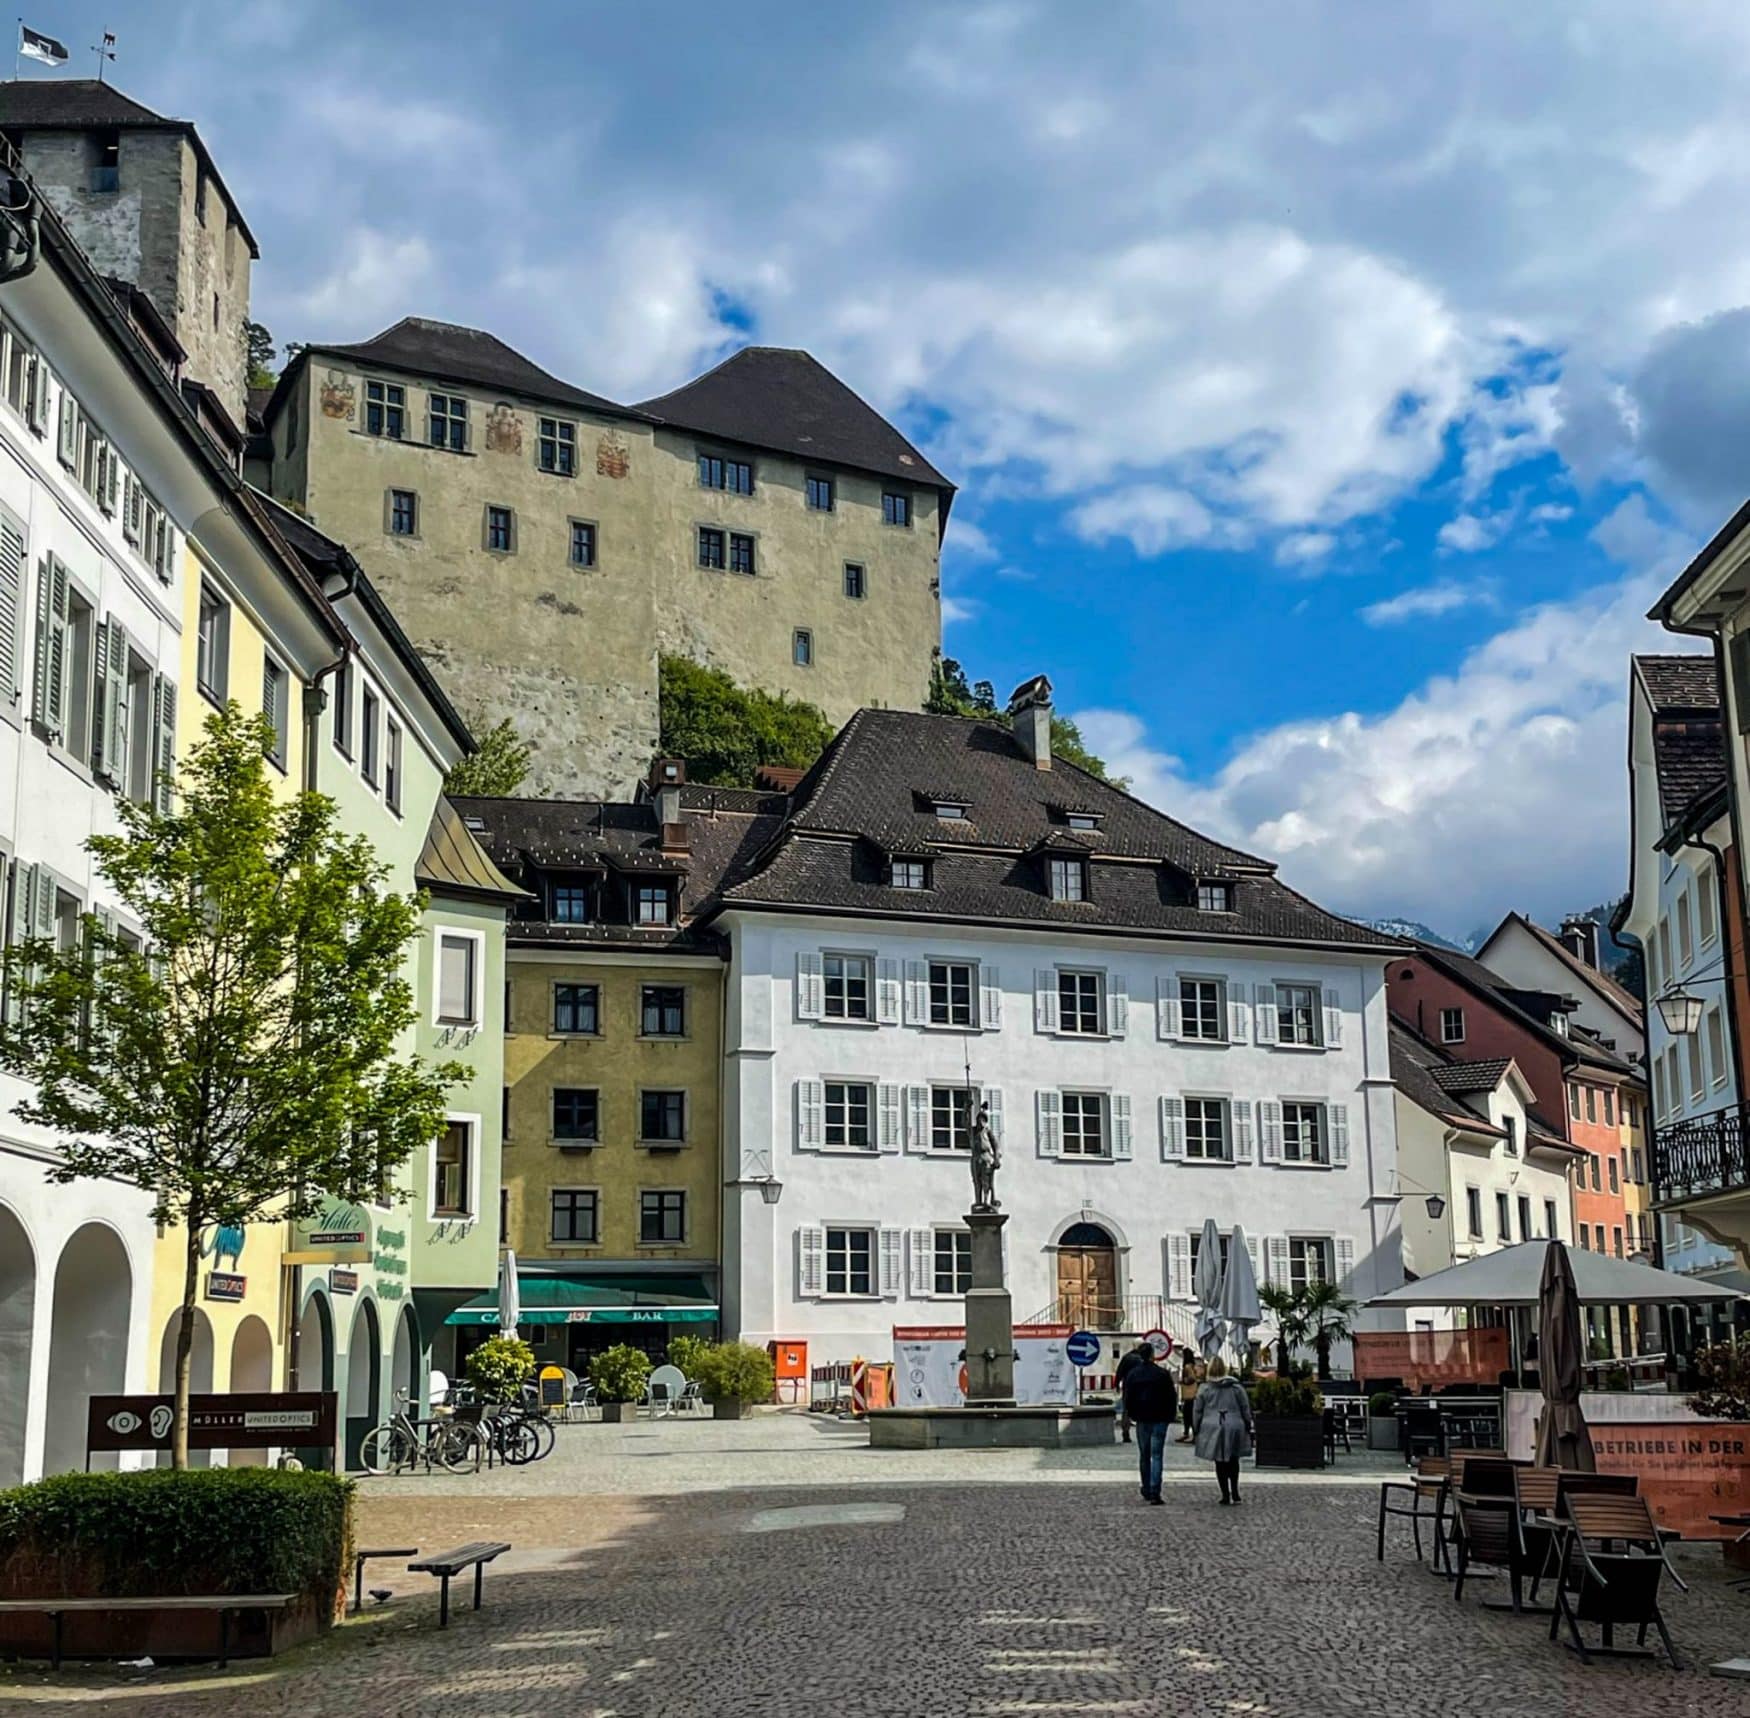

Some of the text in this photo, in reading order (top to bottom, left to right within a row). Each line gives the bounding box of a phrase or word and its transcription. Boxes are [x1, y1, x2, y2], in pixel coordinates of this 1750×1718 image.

[632, 1312, 664, 1321] BAR
[1594, 1440, 1745, 1455] BETRIEBE IN DER
